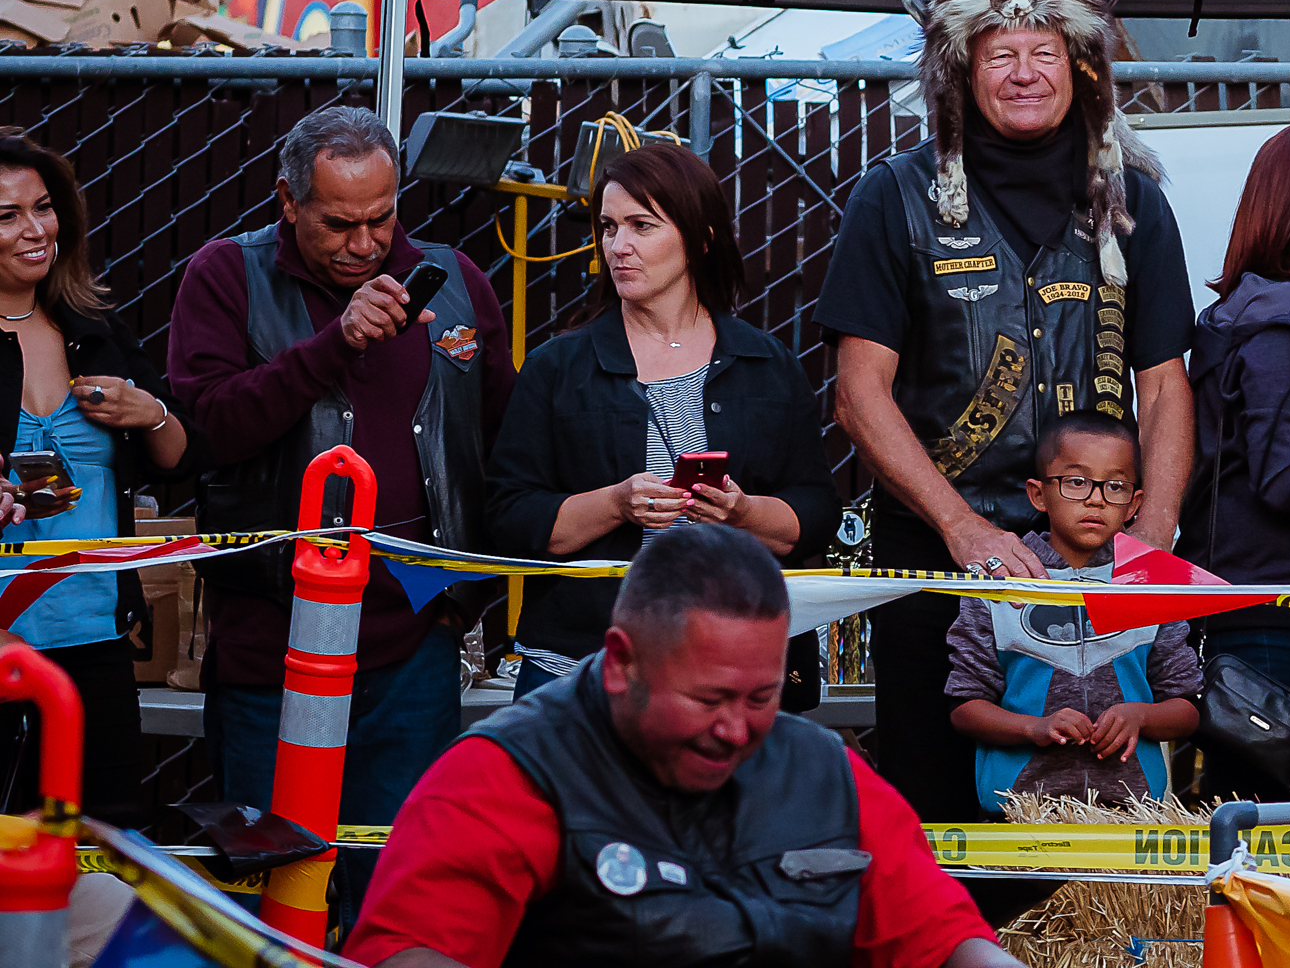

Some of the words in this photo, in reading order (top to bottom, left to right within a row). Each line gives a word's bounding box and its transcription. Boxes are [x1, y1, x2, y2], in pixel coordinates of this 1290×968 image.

[935, 262, 964, 272] MOTHER
[963, 258, 995, 269] CHAPTER
[1041, 285, 1058, 297] JOE
[1059, 284, 1089, 292] BRAVO
[1046, 291, 1086, 301] 1924-2015
